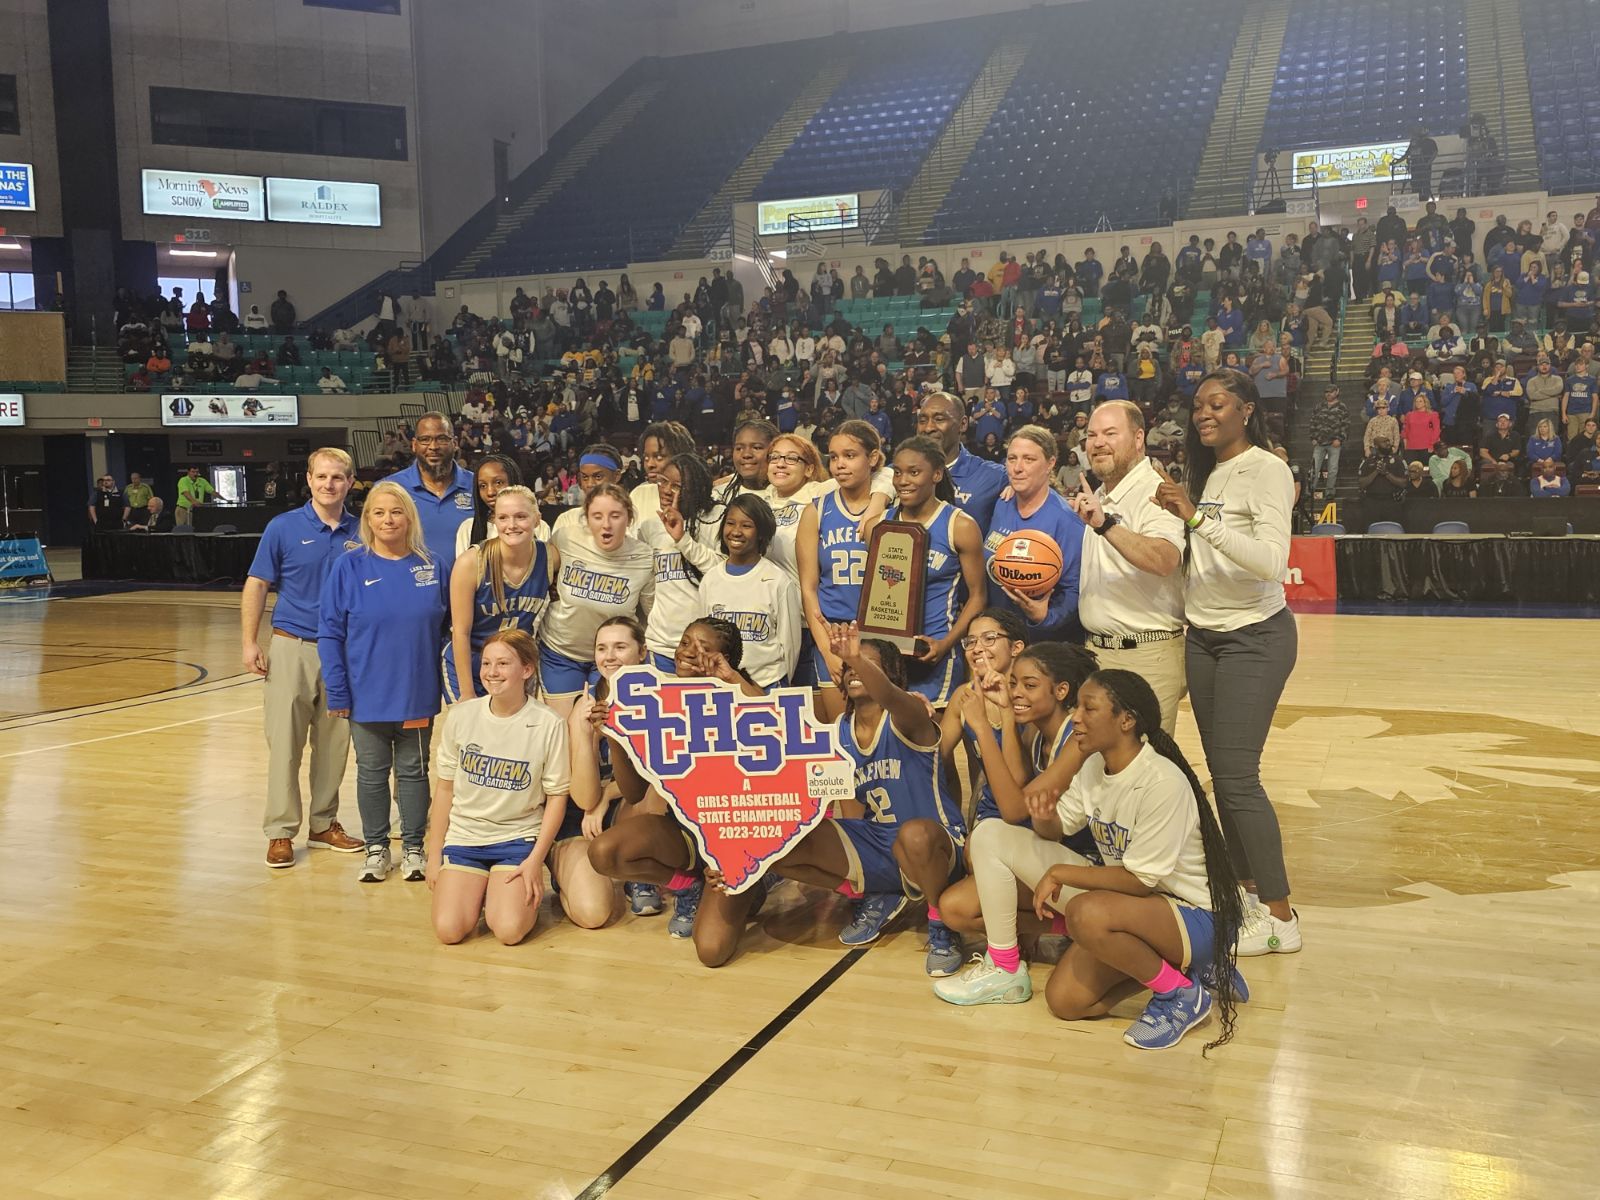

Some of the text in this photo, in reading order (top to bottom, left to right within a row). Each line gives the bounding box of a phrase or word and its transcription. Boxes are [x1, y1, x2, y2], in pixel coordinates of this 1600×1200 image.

[5, 170, 26, 180] THE
[158, 178, 249, 195] Morning News
[171, 195, 203, 208] SCNOW
[301, 200, 349, 211] RALDEX
[786, 244, 807, 255] 320
[820, 526, 854, 550] LAKE
[881, 553, 908, 561] CHAMPION
[831, 549, 868, 585] 22
[998, 564, 1042, 581] Wilson
[563, 566, 628, 596] LAKE VIEW
[571, 587, 615, 604] WILD GATORS
[480, 597, 517, 617] LAE
[870, 606, 904, 616] BASKETBALL
[735, 611, 767, 632] VIEW
[873, 613, 899, 622] 2023-2024
[613, 668, 834, 778] SCHSL
[460, 750, 528, 781] LAKE VIEW
[469, 774, 513, 790] WILD GATORS
[742, 778, 752, 791] A
[808, 776, 845, 787] absolute
[809, 787, 849, 796] total care
[696, 792, 802, 809] GIRLS BASKETBALL
[697, 808, 802, 824] STATE CHAMPIONS
[718, 825, 783, 840] 2023-2024
